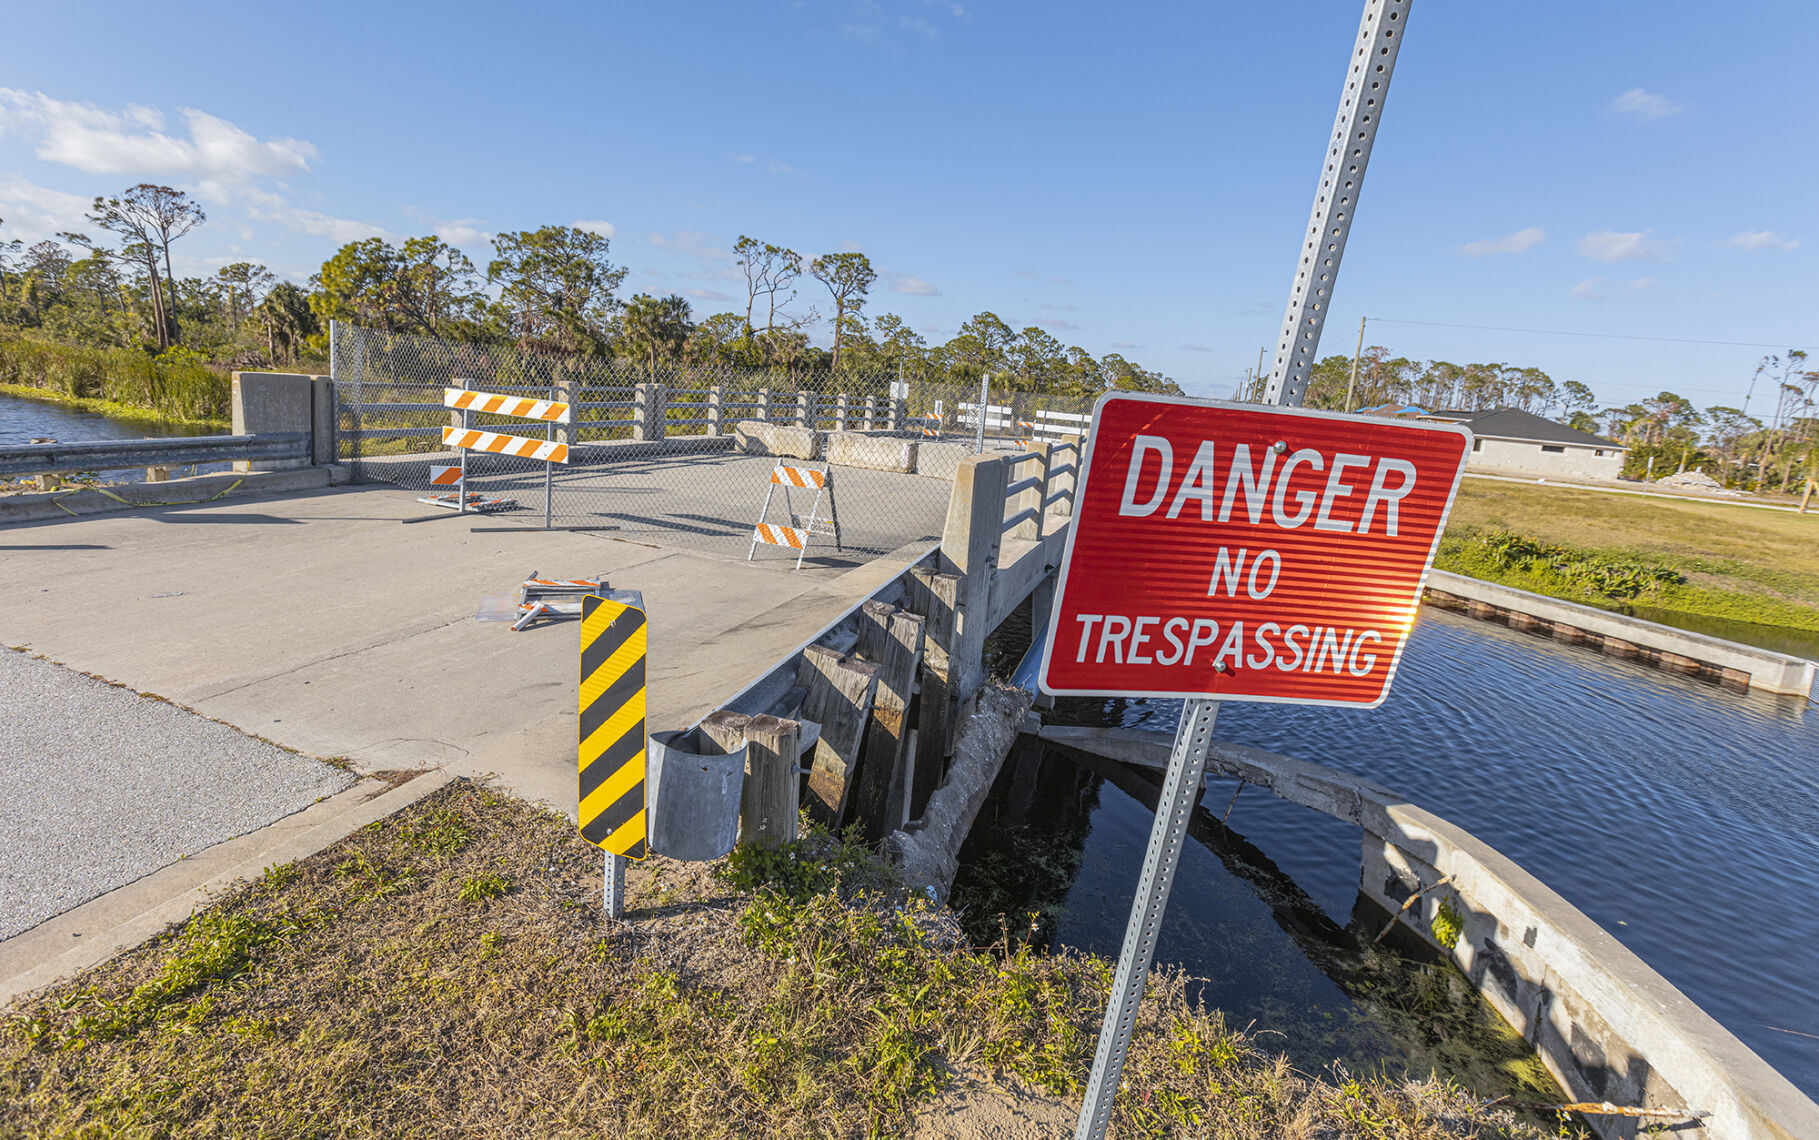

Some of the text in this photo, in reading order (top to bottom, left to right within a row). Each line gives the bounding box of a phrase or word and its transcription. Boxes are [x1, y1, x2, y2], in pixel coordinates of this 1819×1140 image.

[1118, 435, 1417, 537] DANGER
[1207, 547, 1281, 600] NO
[1075, 614, 1382, 677] TRESPASSING
